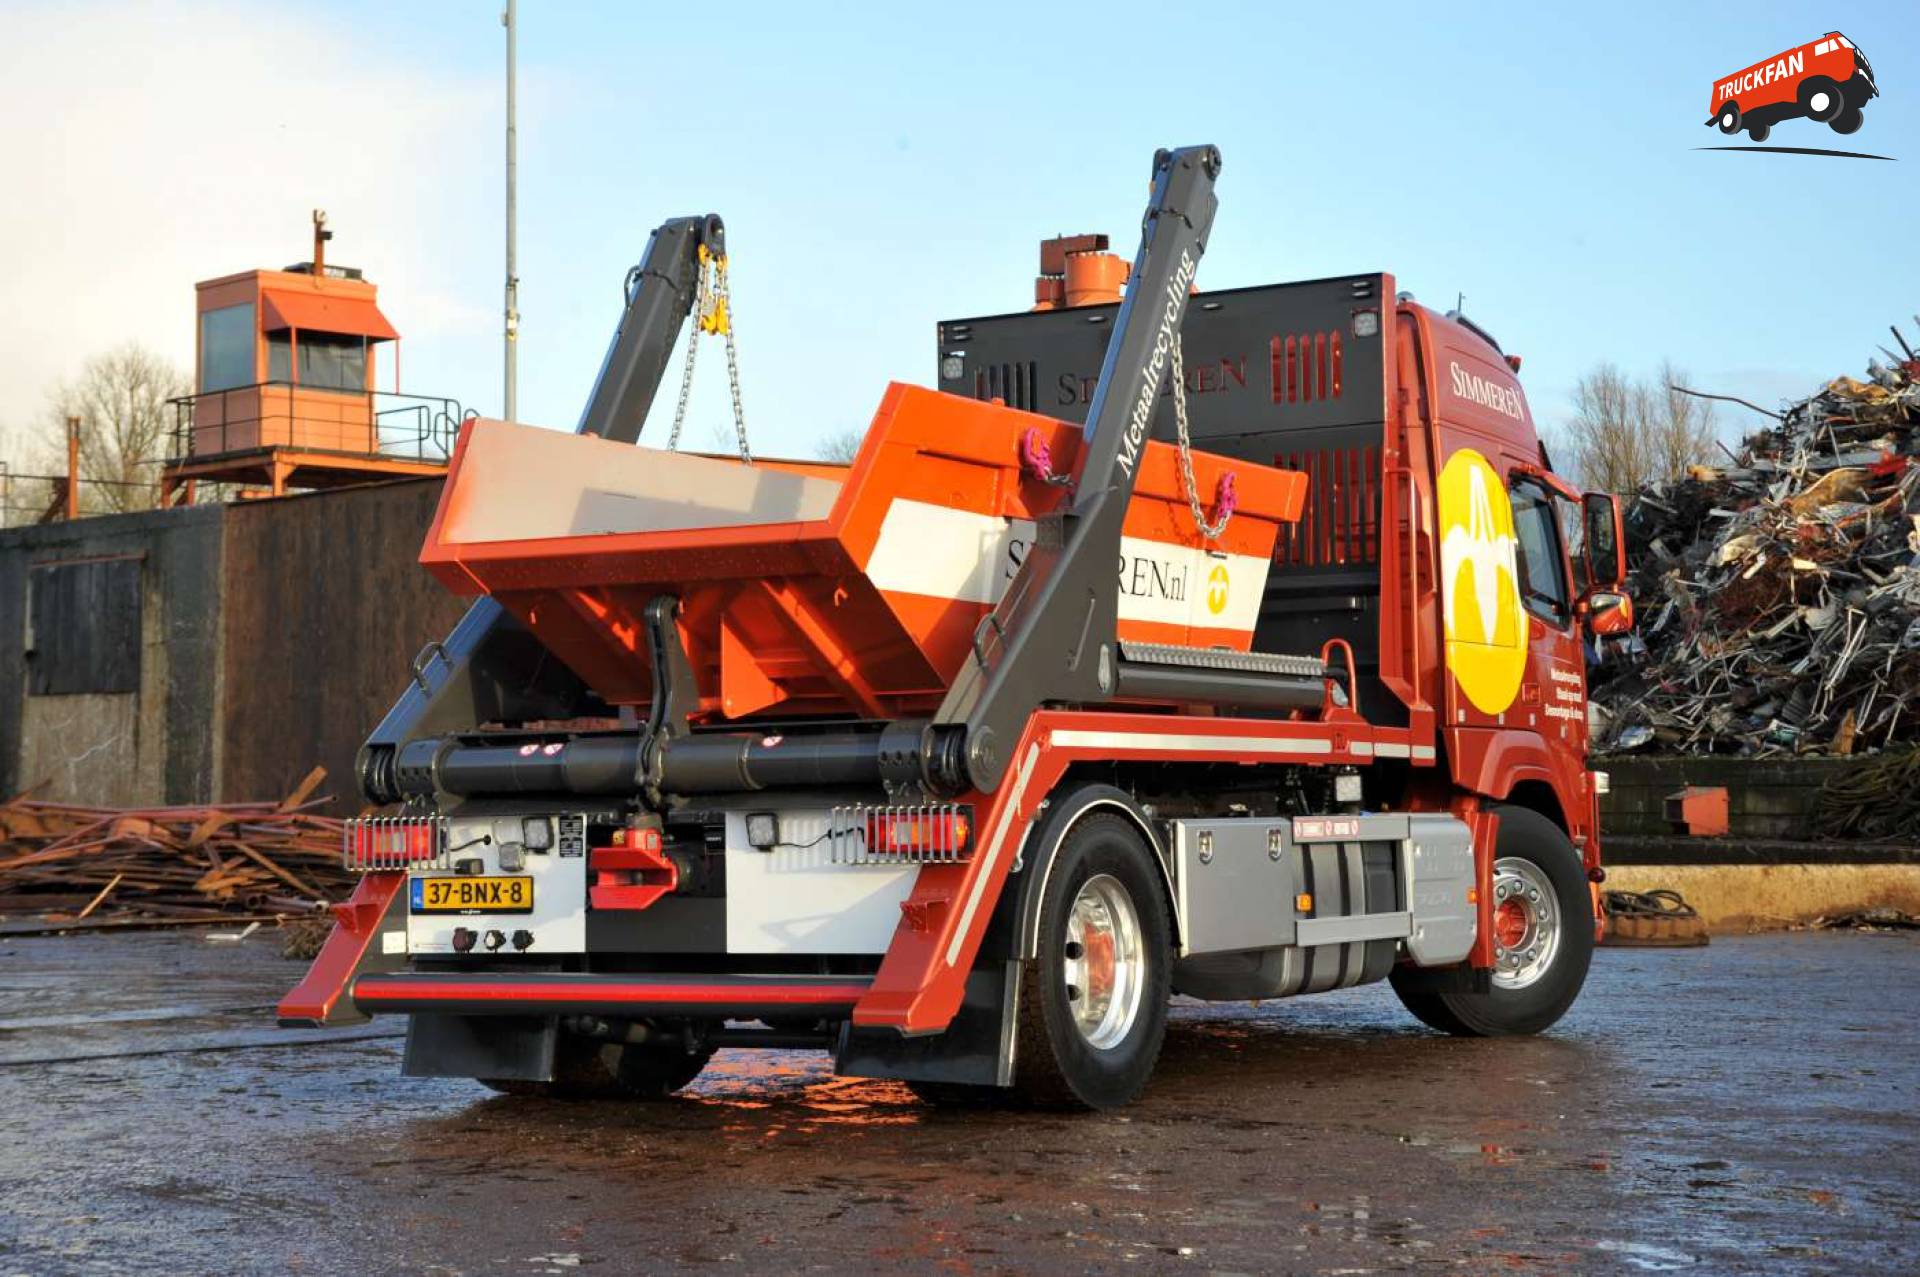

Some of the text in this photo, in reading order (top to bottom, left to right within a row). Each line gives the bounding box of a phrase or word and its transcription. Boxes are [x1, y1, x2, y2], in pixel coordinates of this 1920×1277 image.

[1116, 248, 1195, 480] Metaalrecycling
[1450, 361, 1523, 421] SIMMEREN
[428, 881, 523, 905] 37-BNX-8
